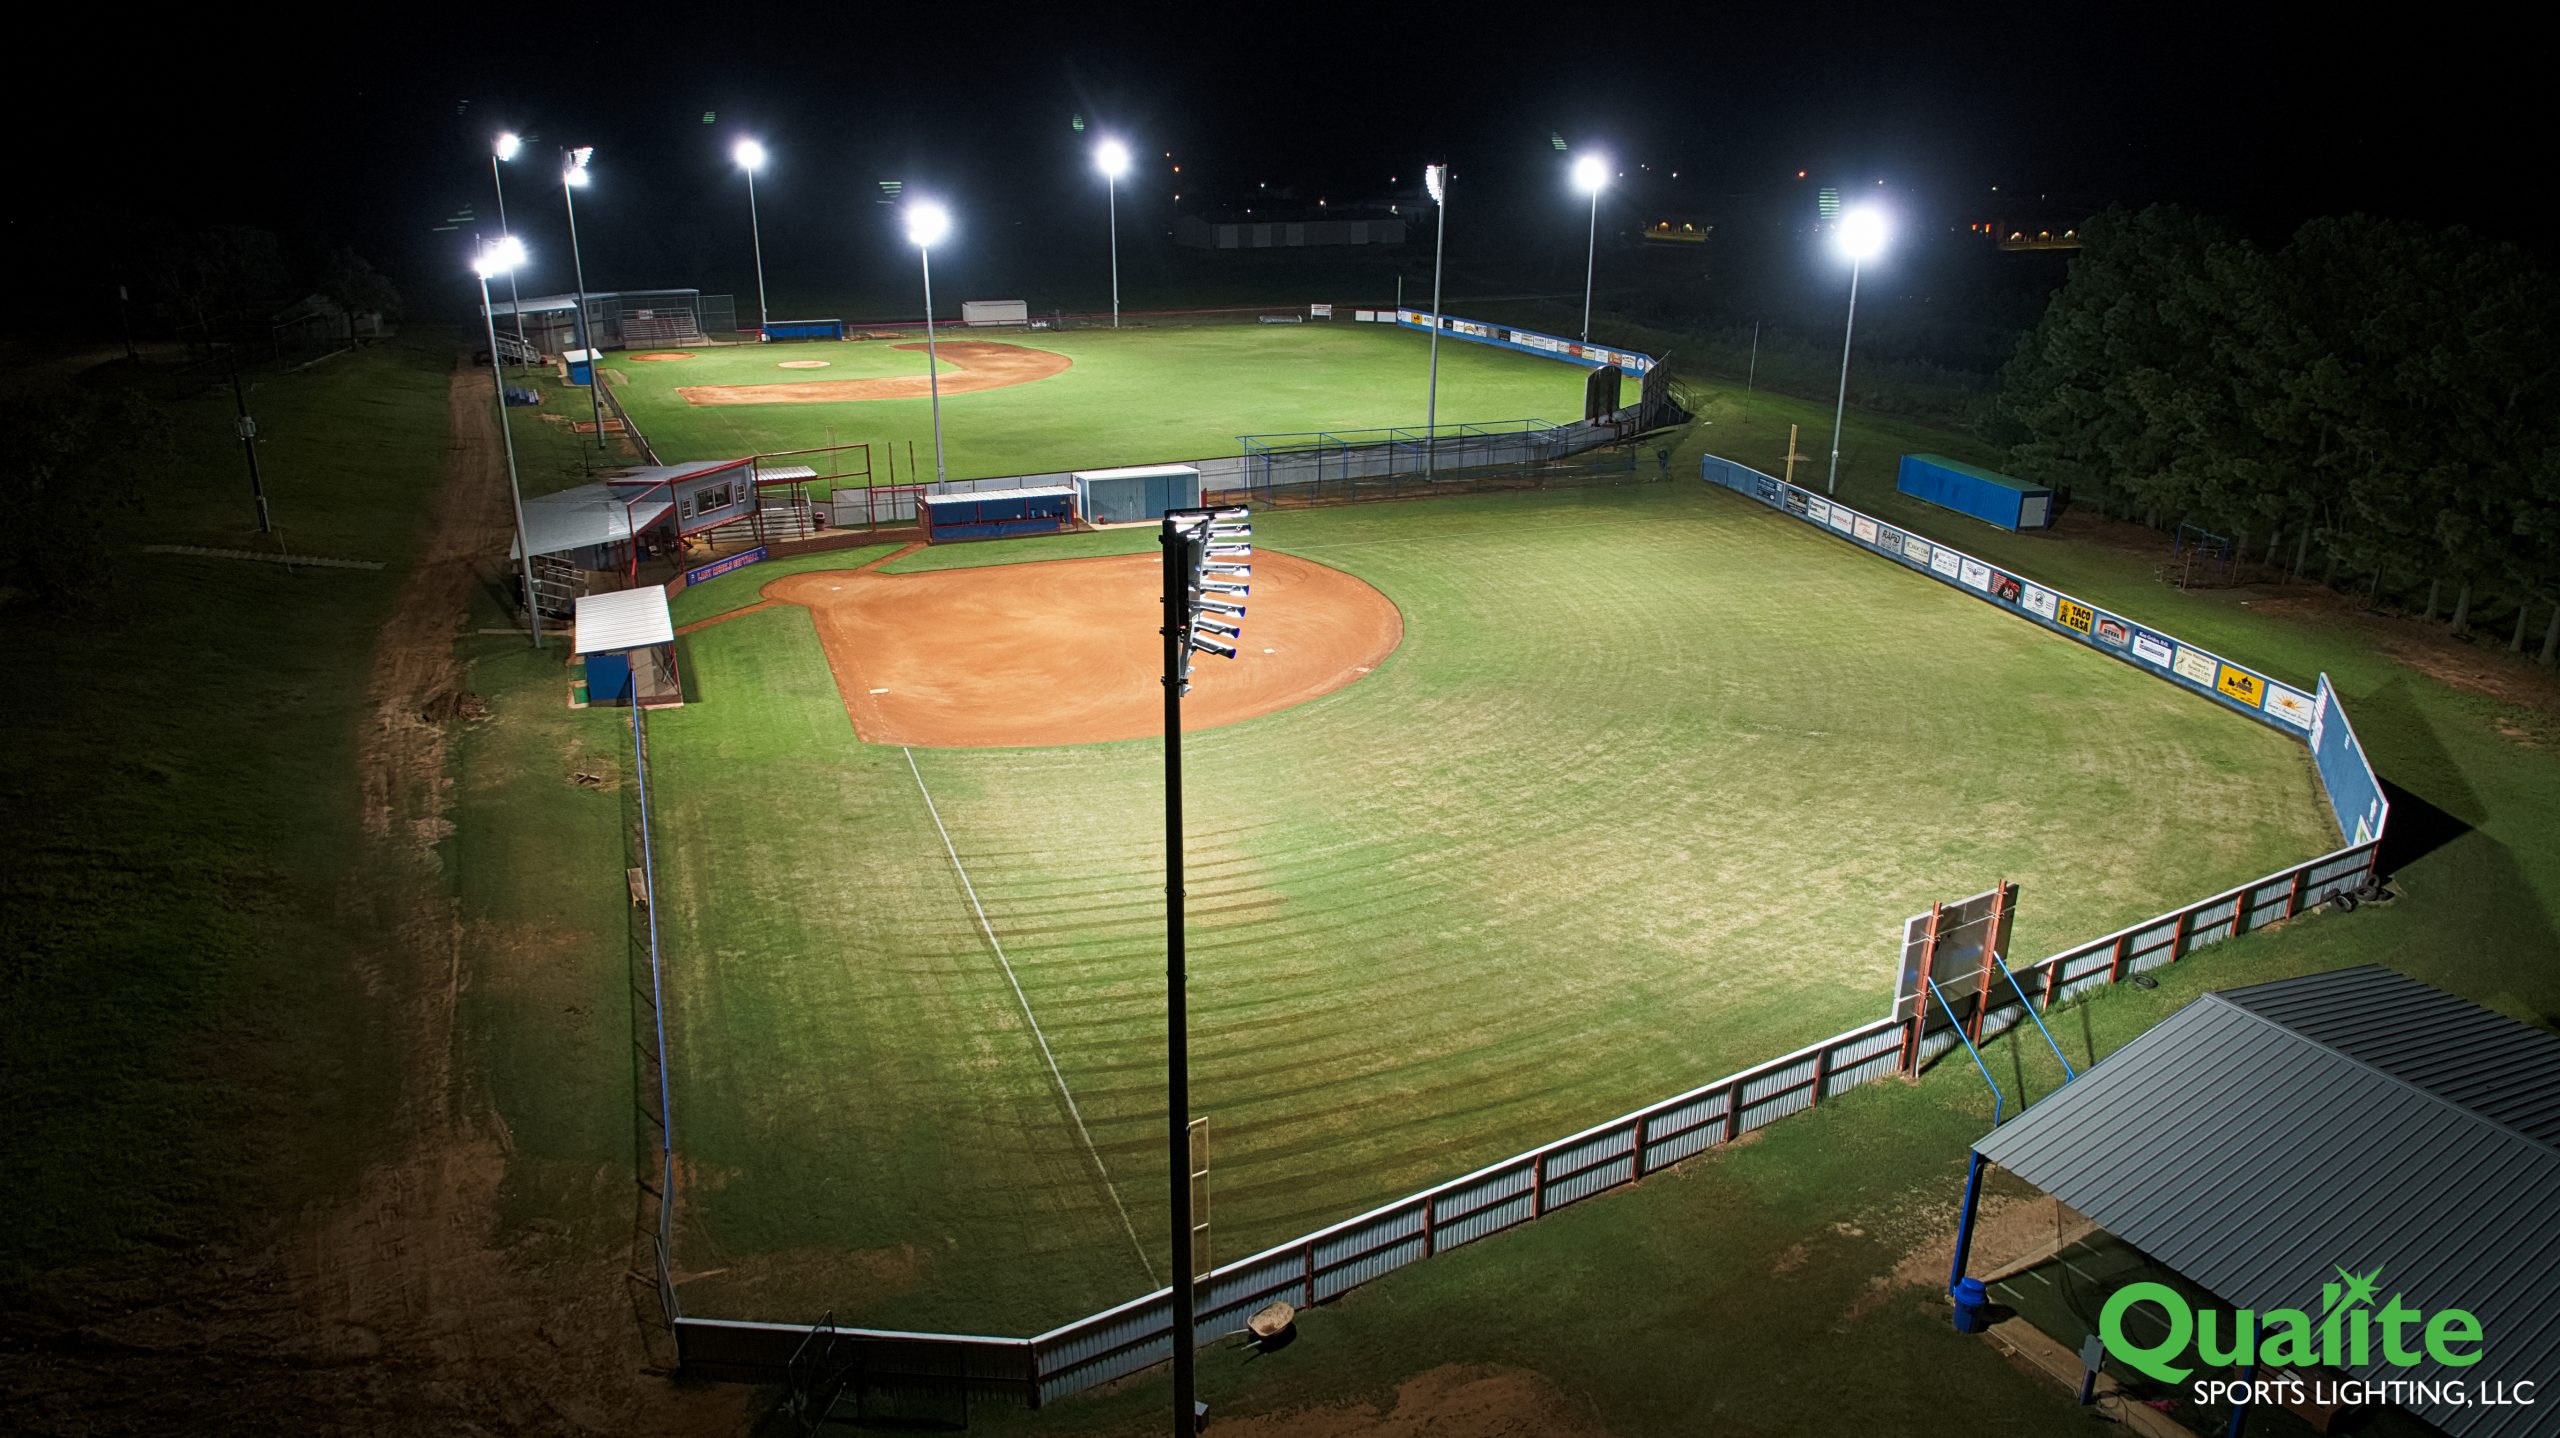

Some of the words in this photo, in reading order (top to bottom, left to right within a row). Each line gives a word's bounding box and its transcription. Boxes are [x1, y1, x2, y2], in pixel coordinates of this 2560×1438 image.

[1881, 529, 1901, 544] RAPID
[2072, 606, 2091, 621] TACO
[2069, 617, 2088, 633] CASA
[2104, 628, 2120, 639] STEEL
